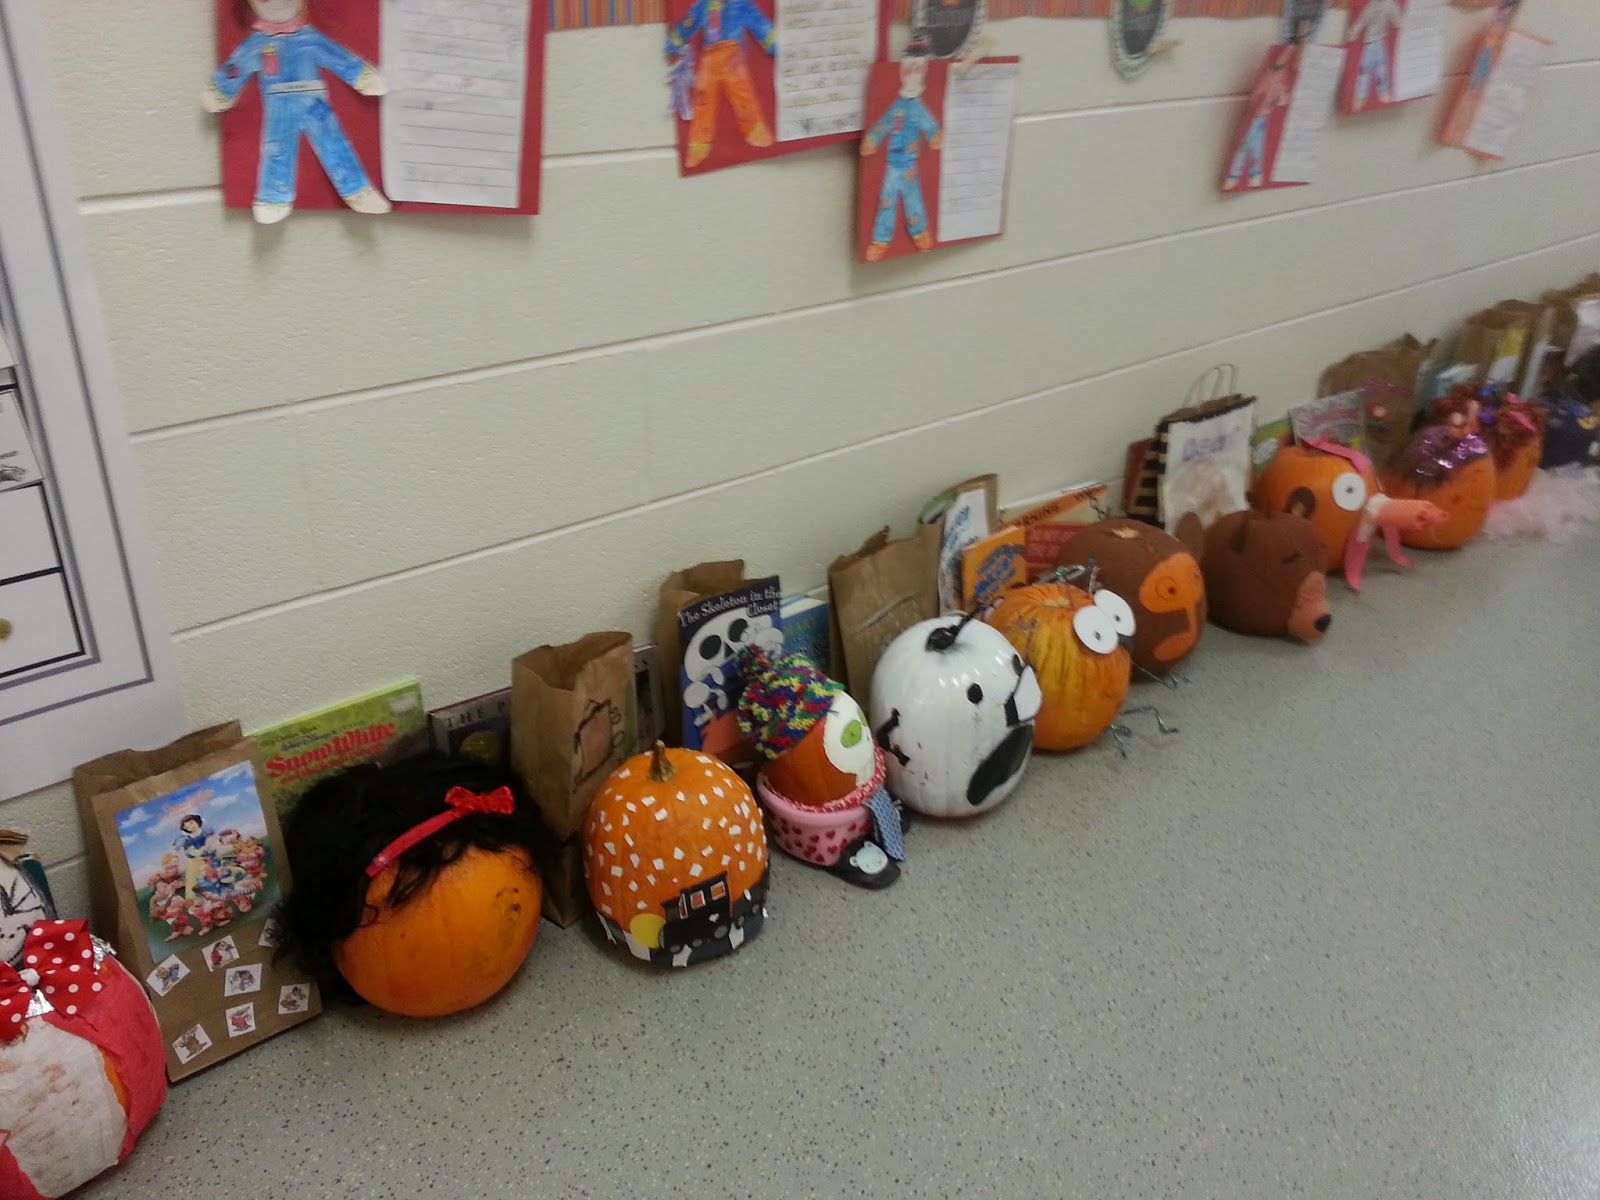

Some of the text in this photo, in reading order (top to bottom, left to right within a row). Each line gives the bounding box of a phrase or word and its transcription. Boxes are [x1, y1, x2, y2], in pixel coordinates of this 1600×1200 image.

[677, 586, 782, 627] The Skeleton in the
[746, 600, 779, 617] Closet
[266, 742, 332, 779] Snow
[331, 722, 395, 755] White
